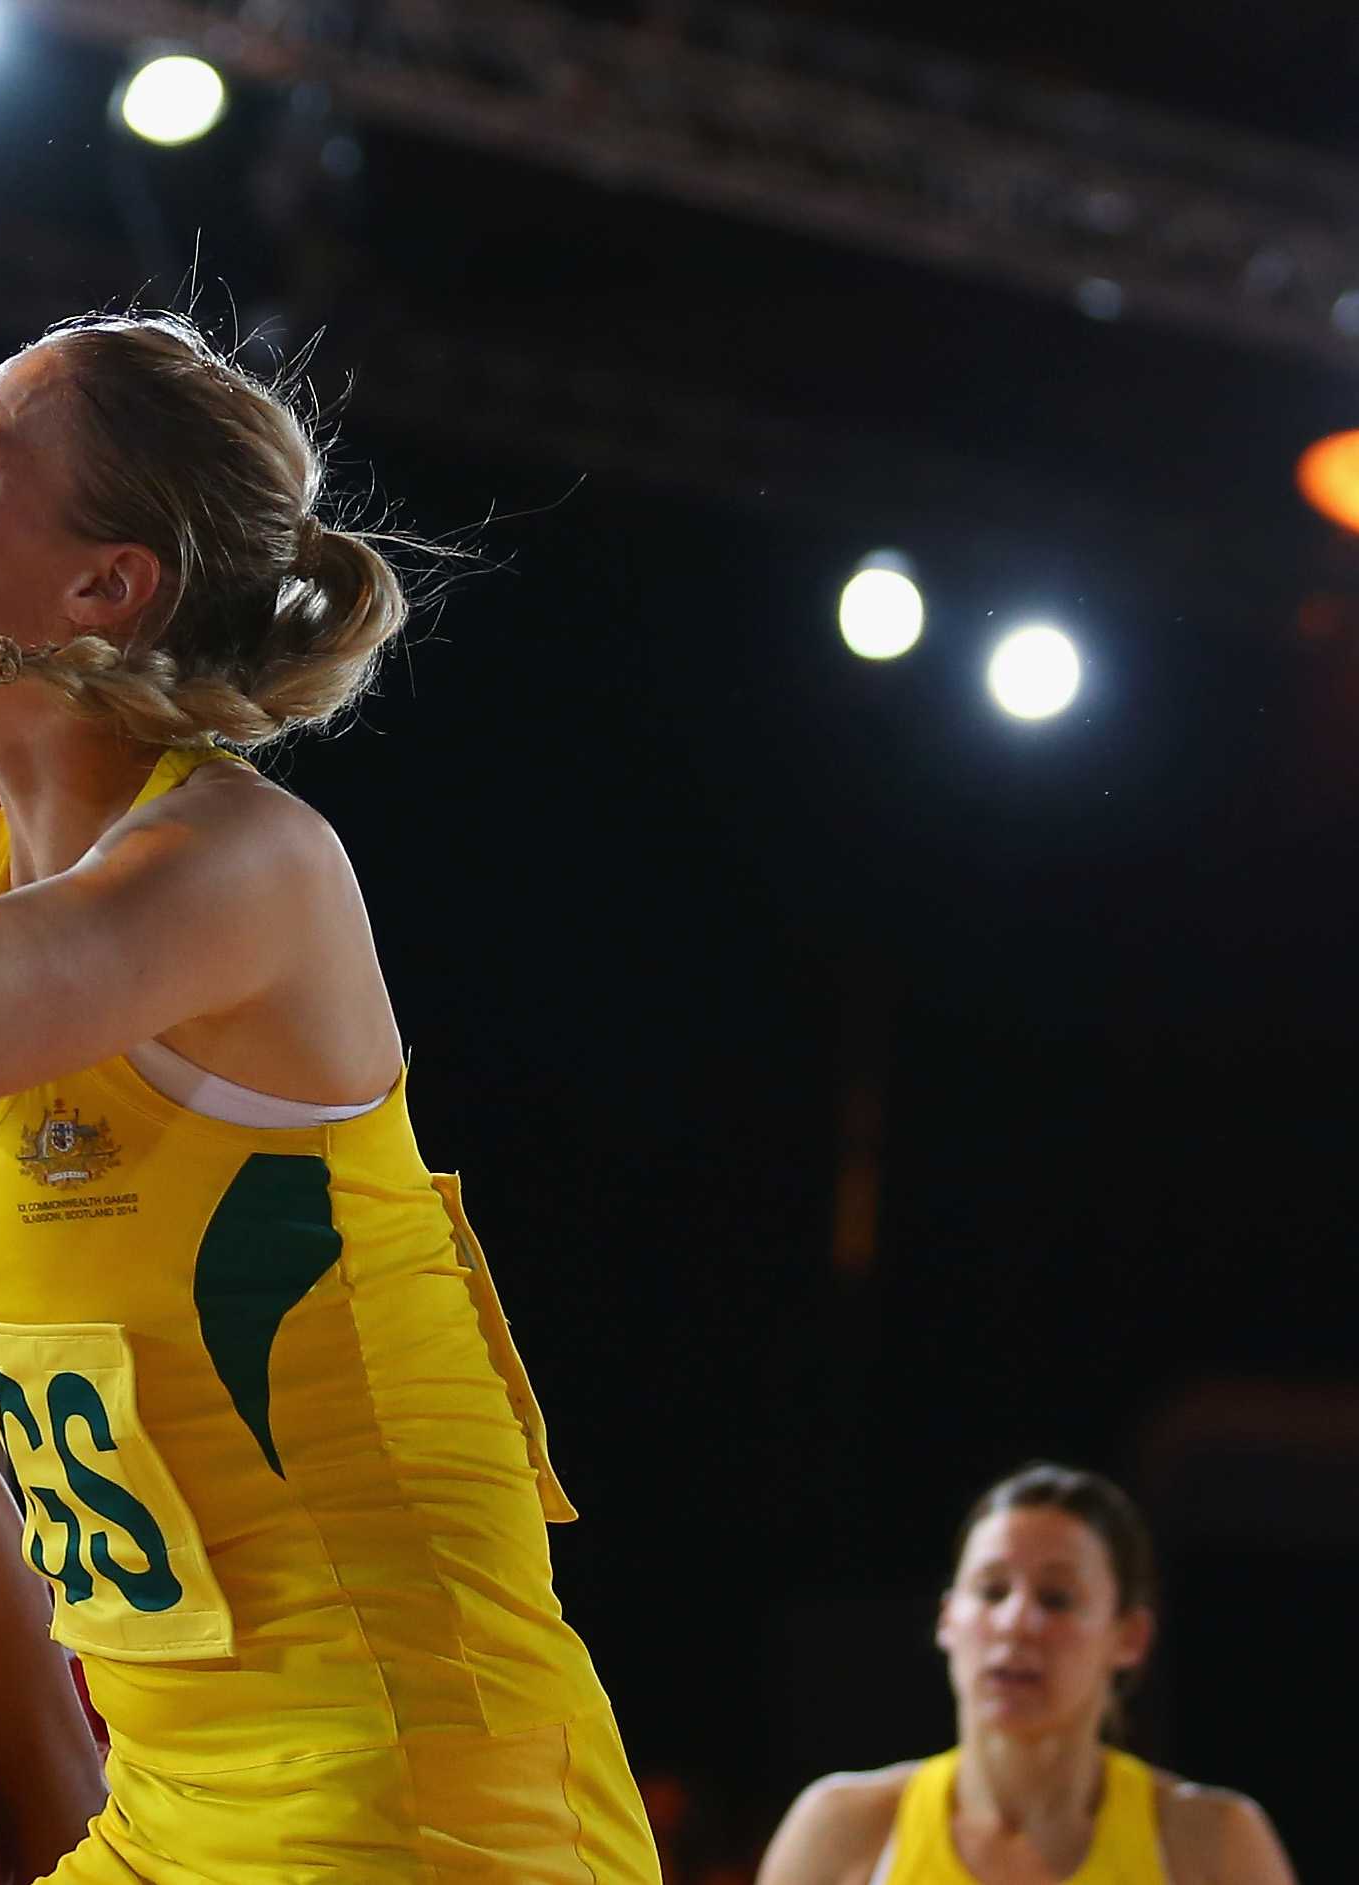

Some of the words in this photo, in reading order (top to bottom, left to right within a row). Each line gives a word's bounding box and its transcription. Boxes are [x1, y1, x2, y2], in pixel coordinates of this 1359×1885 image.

[28, 1197, 101, 1212] COMMONWEALTH
[103, 1193, 139, 1206] GAMES
[65, 1207, 114, 1220] SCOTLAND
[117, 1205, 138, 1217] 2014
